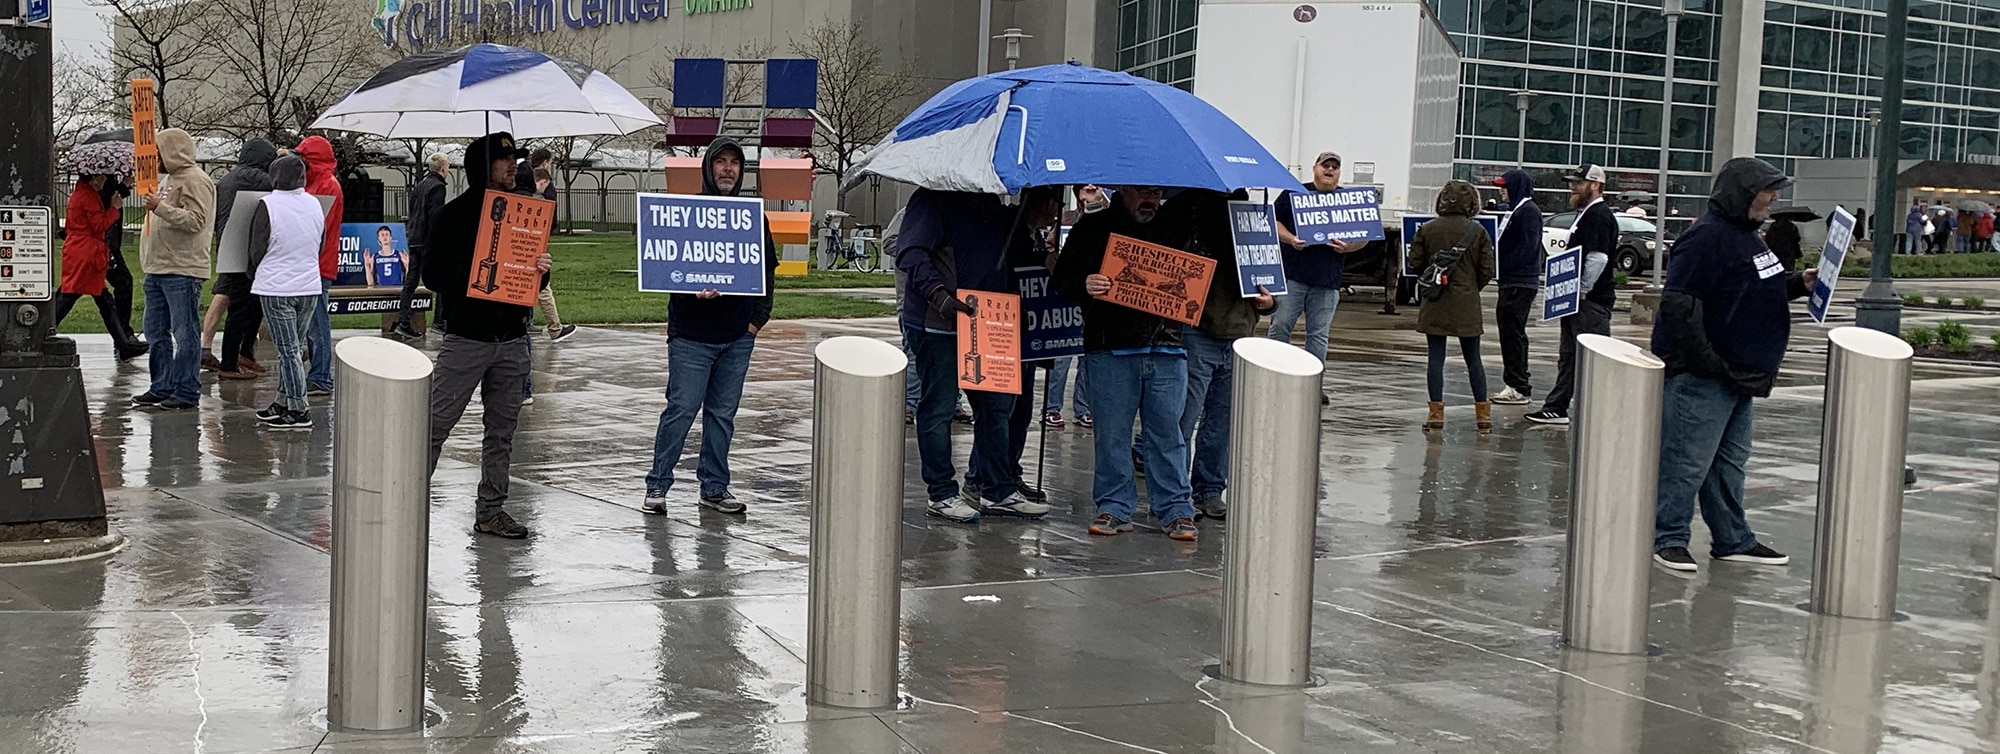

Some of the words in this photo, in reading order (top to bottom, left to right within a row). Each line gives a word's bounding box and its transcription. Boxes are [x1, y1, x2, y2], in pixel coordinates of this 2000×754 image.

[407, 0, 452, 46] CHI
[460, 0, 557, 42] Health
[562, 0, 668, 29] Center
[684, 0, 753, 16] OMAHA
[133, 86, 153, 112] SAFETY
[139, 120, 154, 145] OVER
[137, 154, 156, 181] PROFIT
[517, 202, 542, 216] Red
[1293, 190, 1375, 209] RAILROADER'S
[507, 213, 547, 228] Light
[649, 205, 691, 228] THEY
[695, 207, 727, 229] USE
[730, 209, 752, 230] US
[1296, 211, 1329, 226] LIVES
[1331, 207, 1379, 223] MATTER
[1327, 230, 1368, 239] SMART
[1, 248, 12, 257] 08
[643, 239, 678, 261] AND
[682, 240, 735, 263] ABUSE
[738, 243, 761, 264] US
[1131, 244, 1190, 267] RESPECT
[384, 263, 392, 276] 5
[1129, 254, 1150, 266] OUR
[1151, 260, 1187, 275] RIGHTS
[685, 273, 735, 284] SMART
[986, 299, 1010, 310] Red
[1115, 294, 1180, 317] COMMUNITY!
[1116, 286, 1159, 304] PROTECT
[1159, 297, 1182, 310] YOUR
[981, 310, 1016, 321] Light
